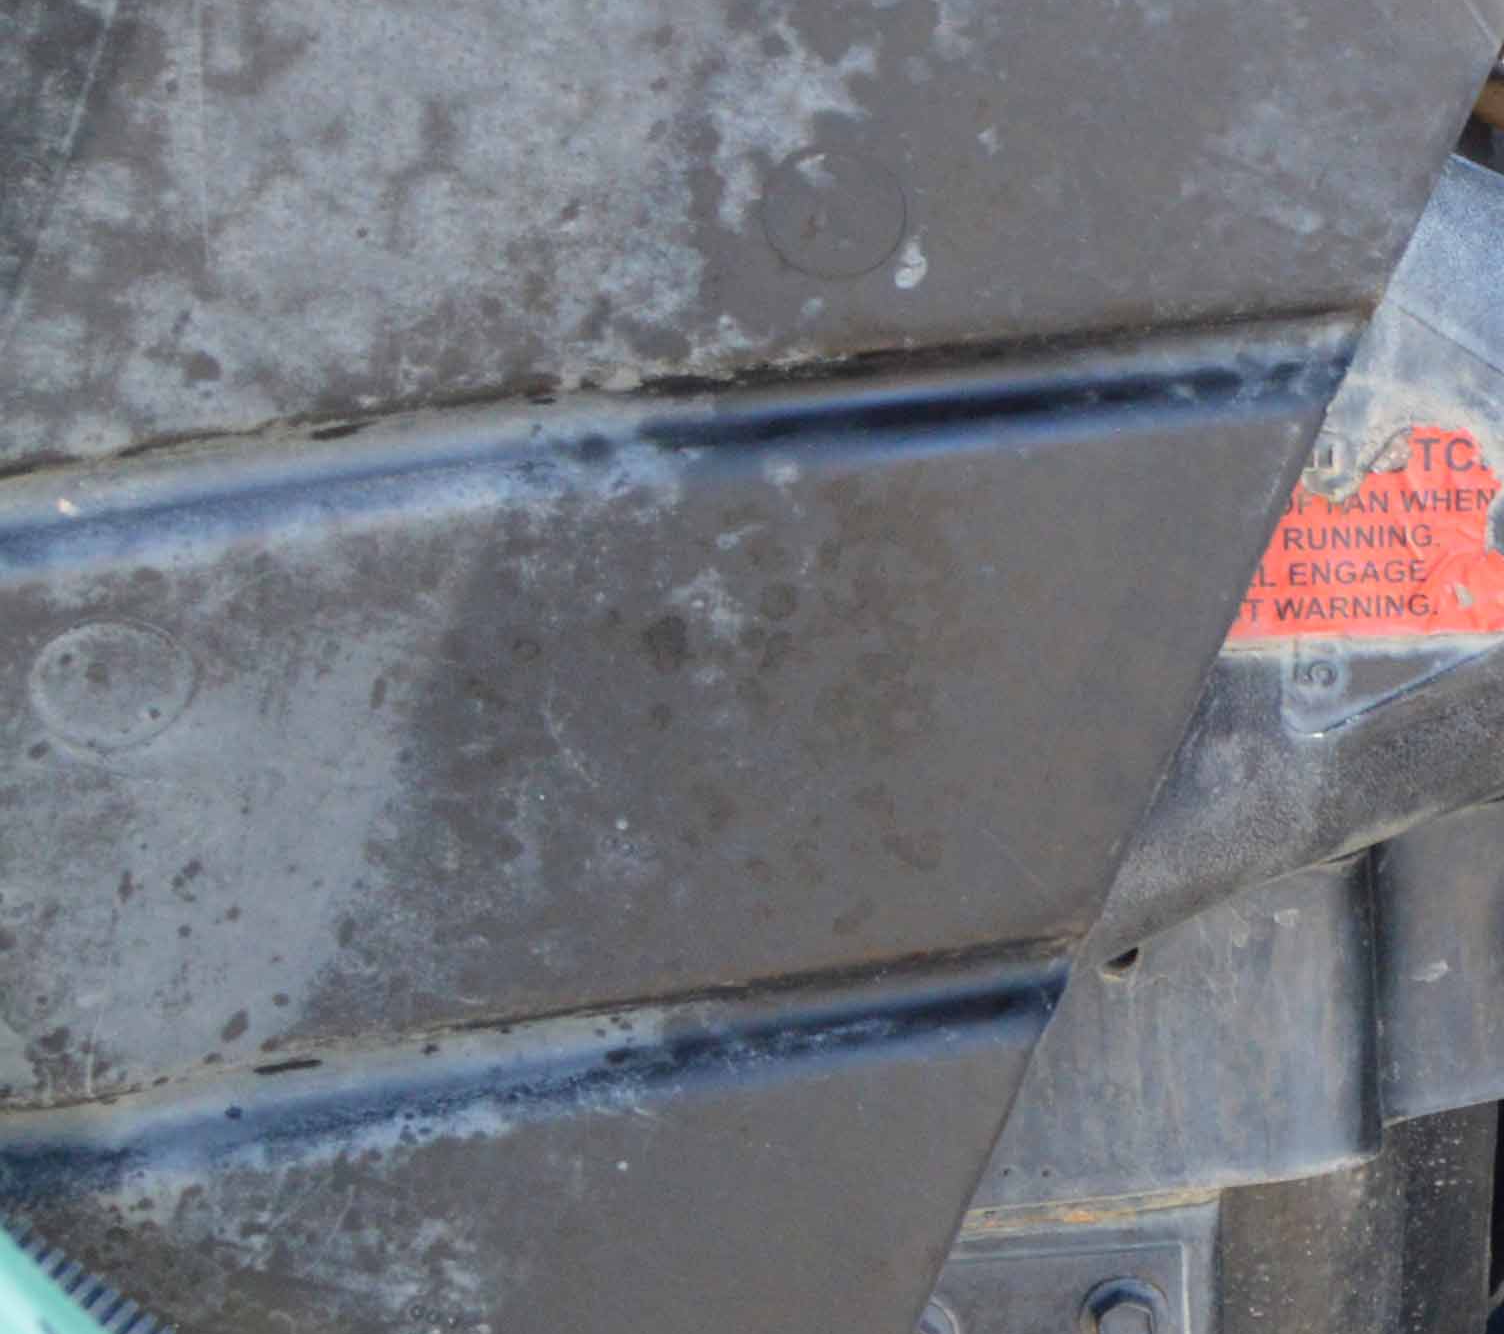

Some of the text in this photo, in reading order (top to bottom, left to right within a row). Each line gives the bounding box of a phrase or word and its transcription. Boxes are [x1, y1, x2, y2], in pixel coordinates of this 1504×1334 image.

[1412, 436, 1489, 473] TC
[1400, 487, 1496, 513] WHEN
[1282, 524, 1441, 551] RUNNING.
[1289, 560, 1429, 588] ENGAGE
[1240, 594, 1439, 622] T WARNING.
